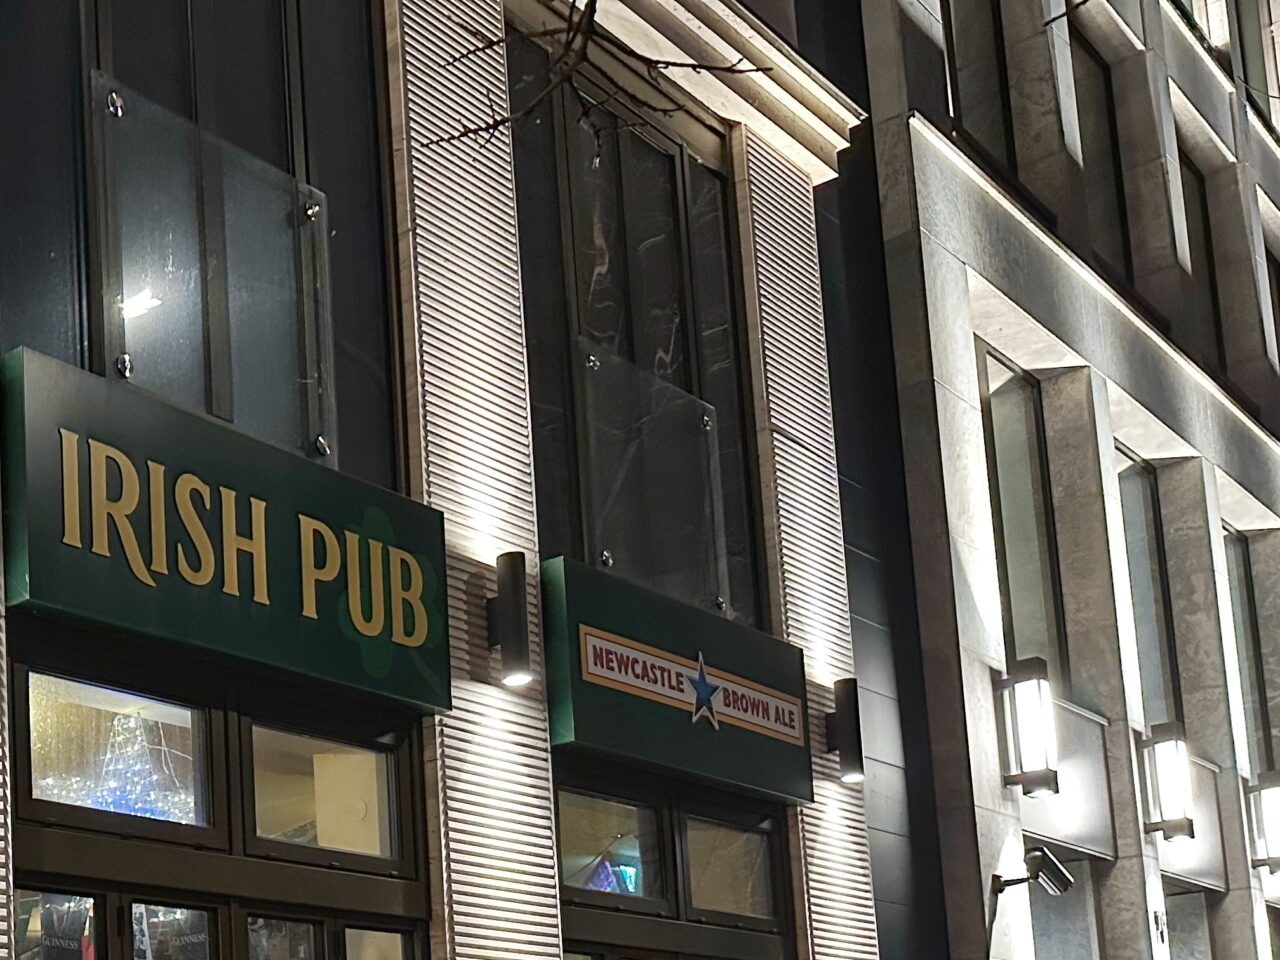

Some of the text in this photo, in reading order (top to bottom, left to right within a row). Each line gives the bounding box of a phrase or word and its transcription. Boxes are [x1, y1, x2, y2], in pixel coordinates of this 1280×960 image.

[58, 427, 428, 647] IRISH PUB
[592, 644, 796, 730] NEWCASTLE BROWN ALE
[42, 935, 79, 950] GUINNESS
